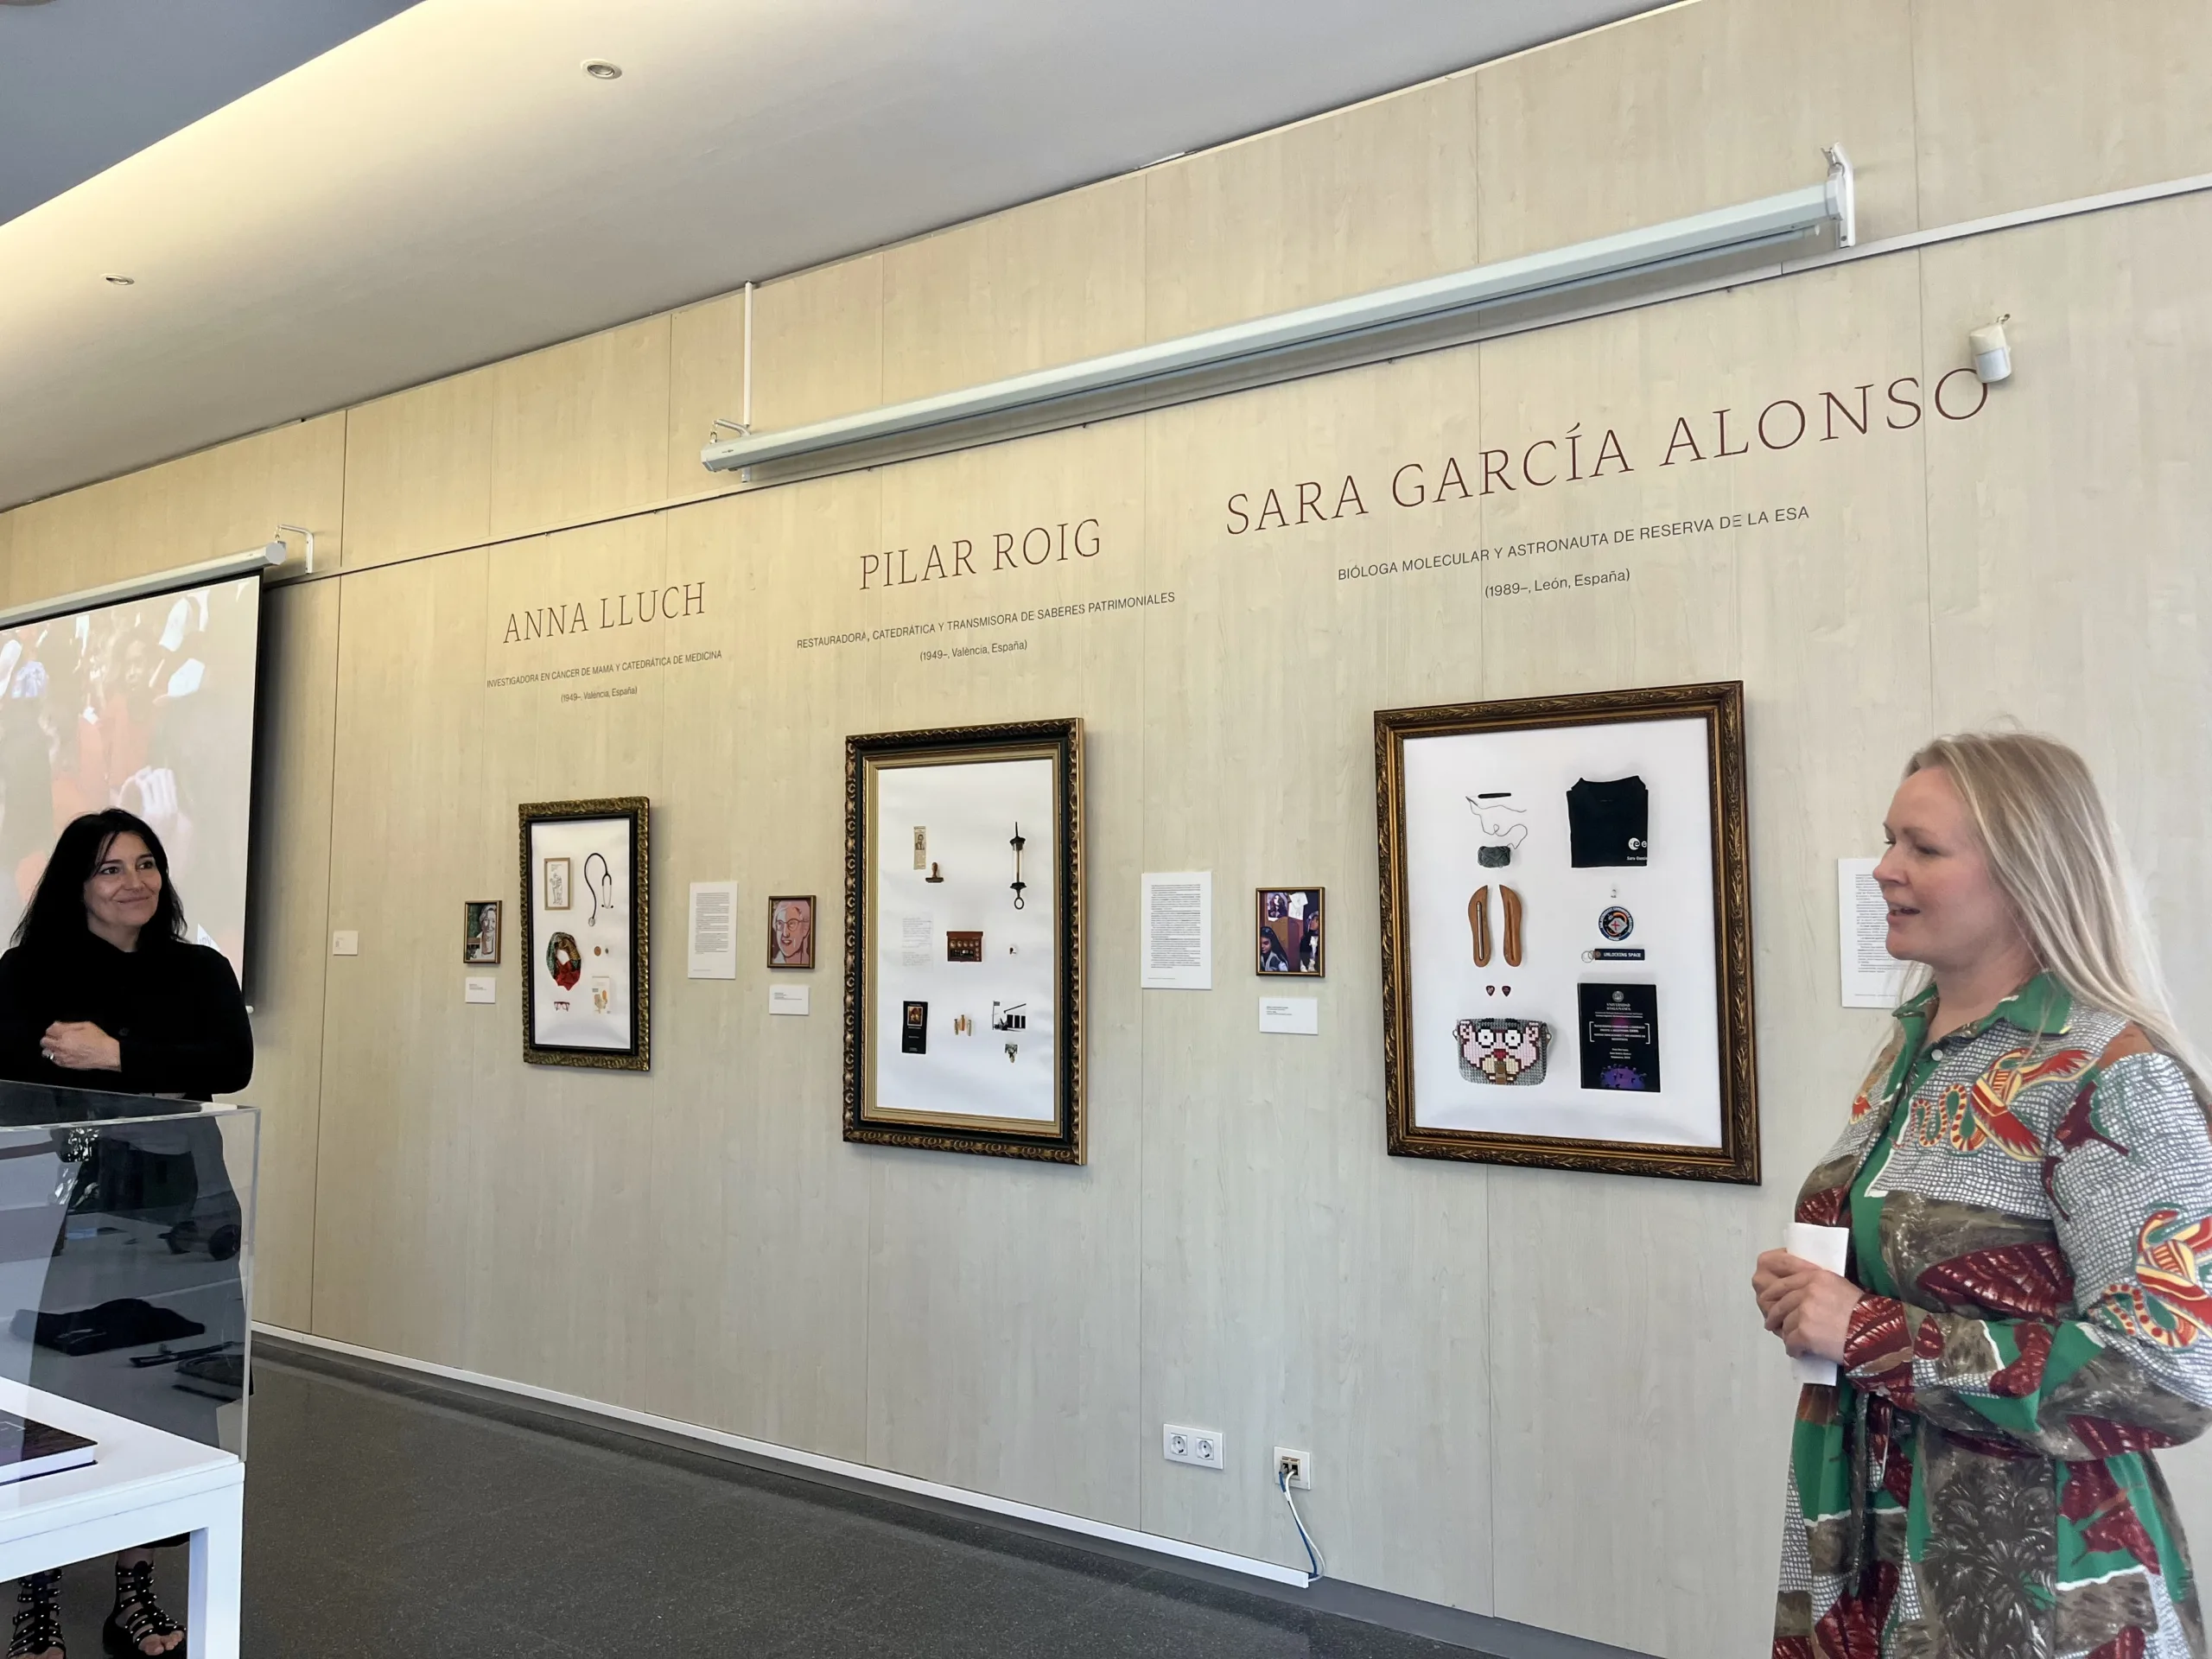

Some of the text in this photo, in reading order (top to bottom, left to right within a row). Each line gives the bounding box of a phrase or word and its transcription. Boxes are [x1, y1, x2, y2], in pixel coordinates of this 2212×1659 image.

[1227, 367, 1987, 534] SARA GARCÍA ALONSO
[860, 518, 1099, 590] PILAR ROIG
[1338, 505, 1809, 580] BIÓLOGA MOLECULAR Y ASTRONAUTA DE RESERVA DE LA ESA
[1535, 576, 1571, 592] León,
[1574, 569, 1630, 587] España)
[503, 582, 706, 644] ANNA LLUCH
[797, 592, 1175, 649] RESTAURADORA, CATEDRÁTICA Y TRANSMISORA DE SABERES PATRIMONIALES
[486, 674, 539, 688] INVESTIGADORA
[540, 672, 550, 682] EN
[581, 667, 590, 677] DE
[592, 664, 613, 674] MAMA
[622, 657, 671, 671] CATEDRÁTICA
[673, 654, 683, 664] DE
[684, 650, 722, 663] MEDICINA
[991, 639, 1028, 655] España)
[611, 686, 638, 697] España)
